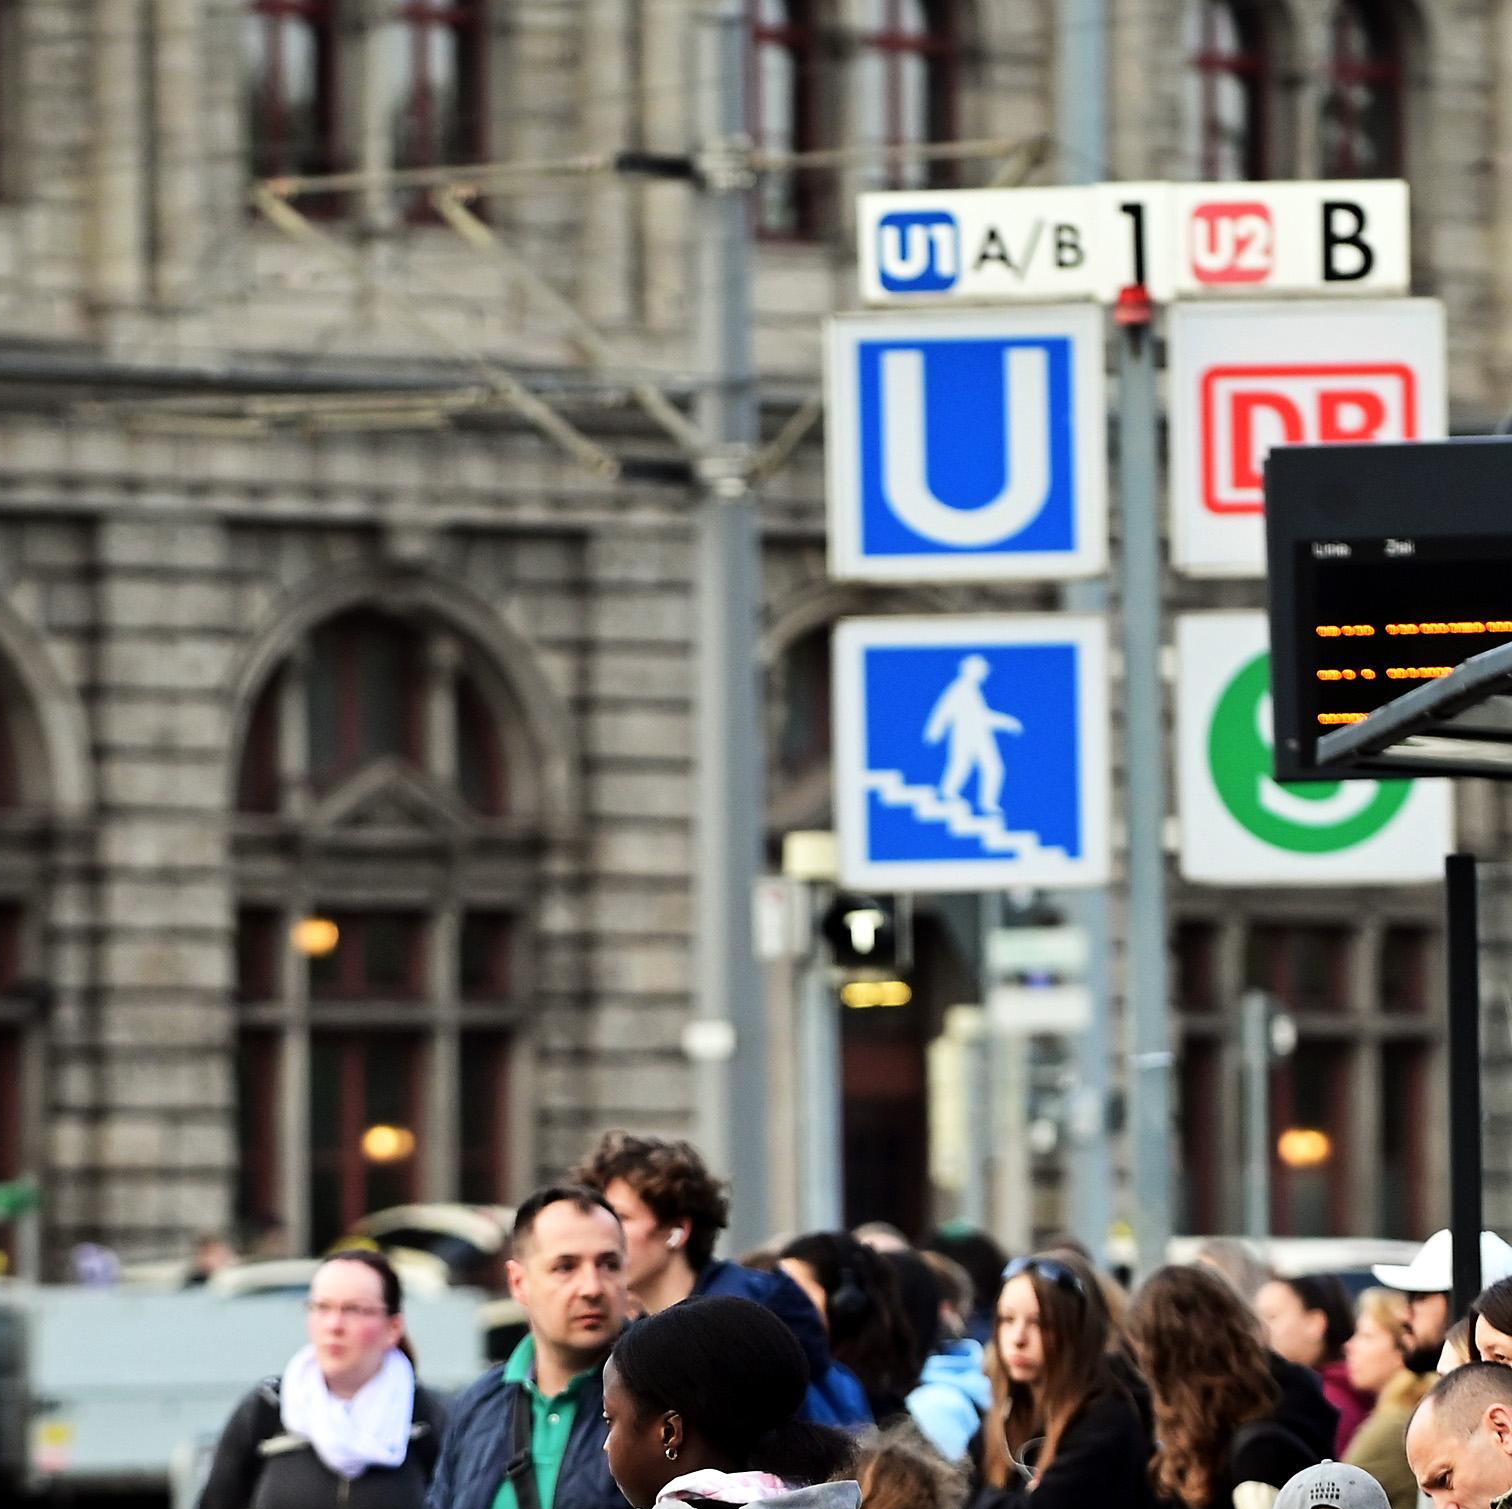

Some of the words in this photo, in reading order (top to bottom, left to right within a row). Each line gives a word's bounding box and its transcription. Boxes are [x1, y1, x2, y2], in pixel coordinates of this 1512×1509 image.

[881, 222, 957, 281] U1
[1193, 214, 1272, 273] U2
[1321, 202, 1374, 282] B
[879, 346, 1052, 547] U
